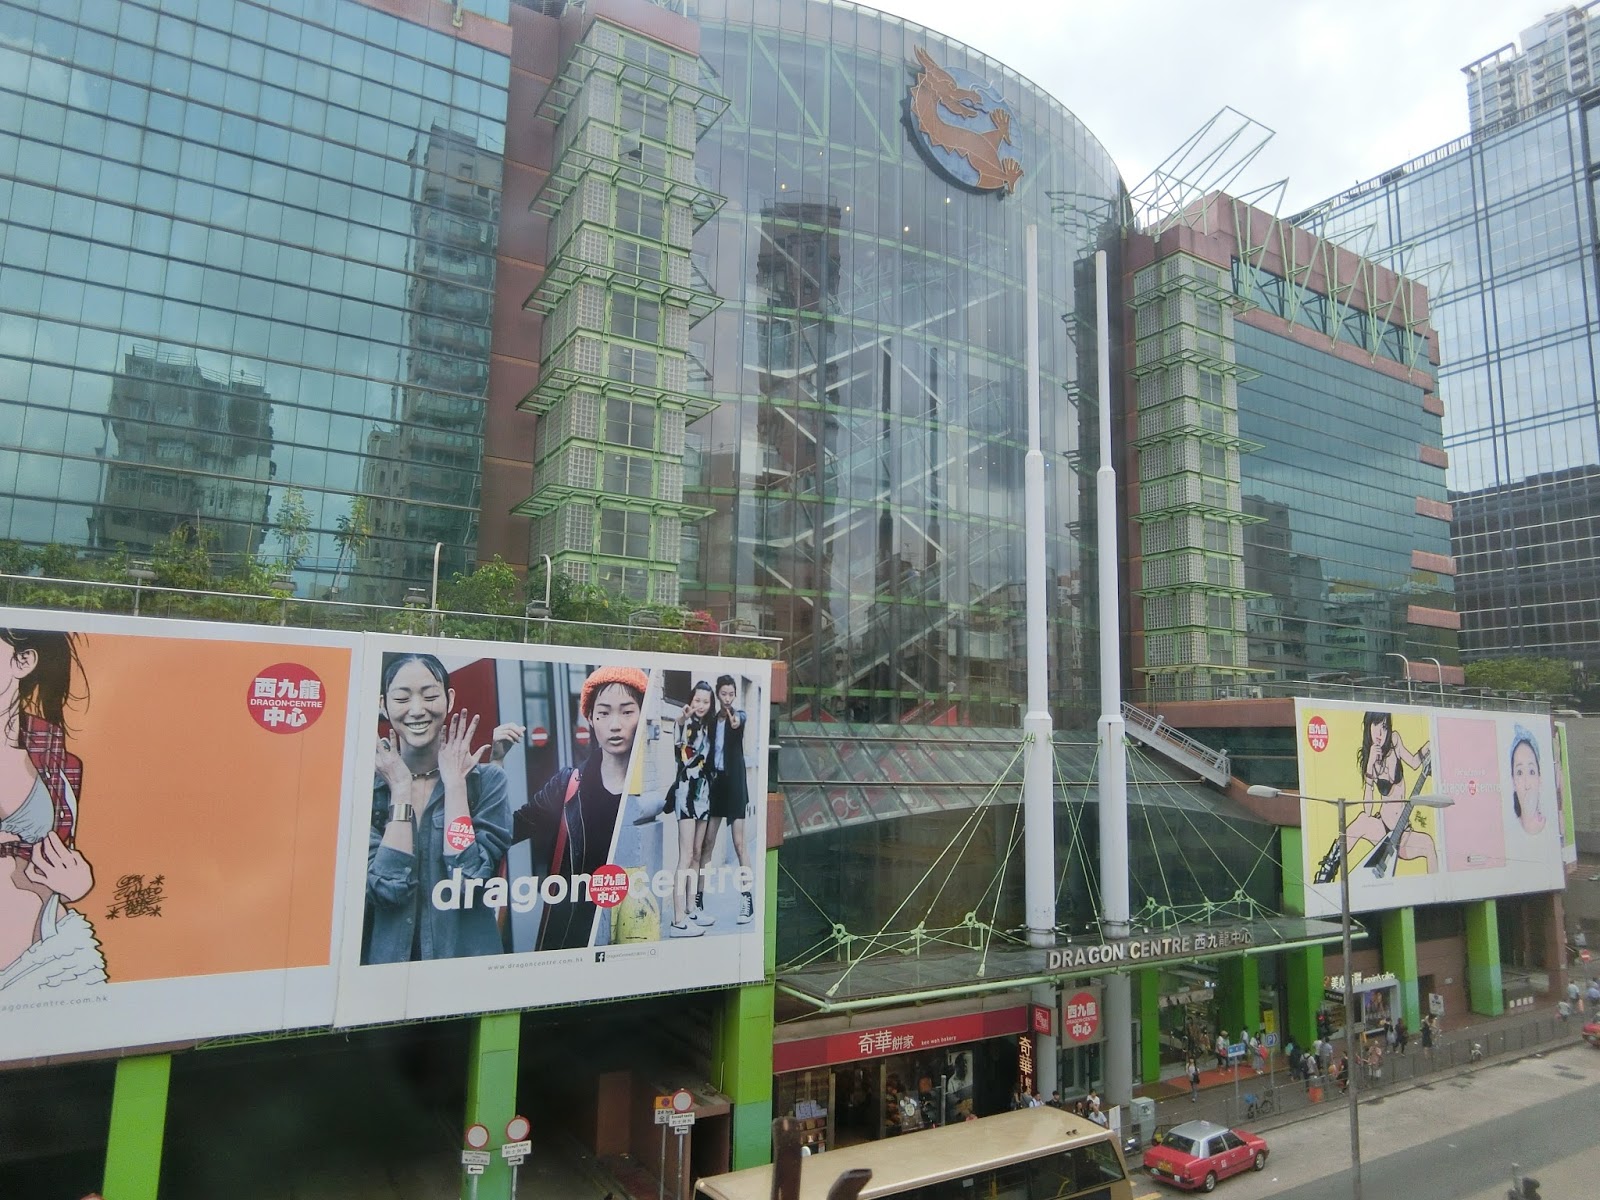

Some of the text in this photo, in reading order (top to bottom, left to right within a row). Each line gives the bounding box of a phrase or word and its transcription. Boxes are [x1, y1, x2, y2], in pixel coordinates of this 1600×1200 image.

[254, 677, 321, 699] 西九龍
[263, 706, 307, 727] 中心
[431, 860, 754, 913] dragon centre
[592, 873, 627, 887] 西九龍
[597, 891, 620, 903] 中心
[1049, 926, 1251, 970] DRAGON CENTRE 西九龍中心
[488, 957, 583, 971] www.dragoncentre.com.hk
[1067, 1002, 1096, 1019] 西九龍
[1072, 1022, 1092, 1037] 中心
[858, 1029, 914, 1054] 奇華餅家
